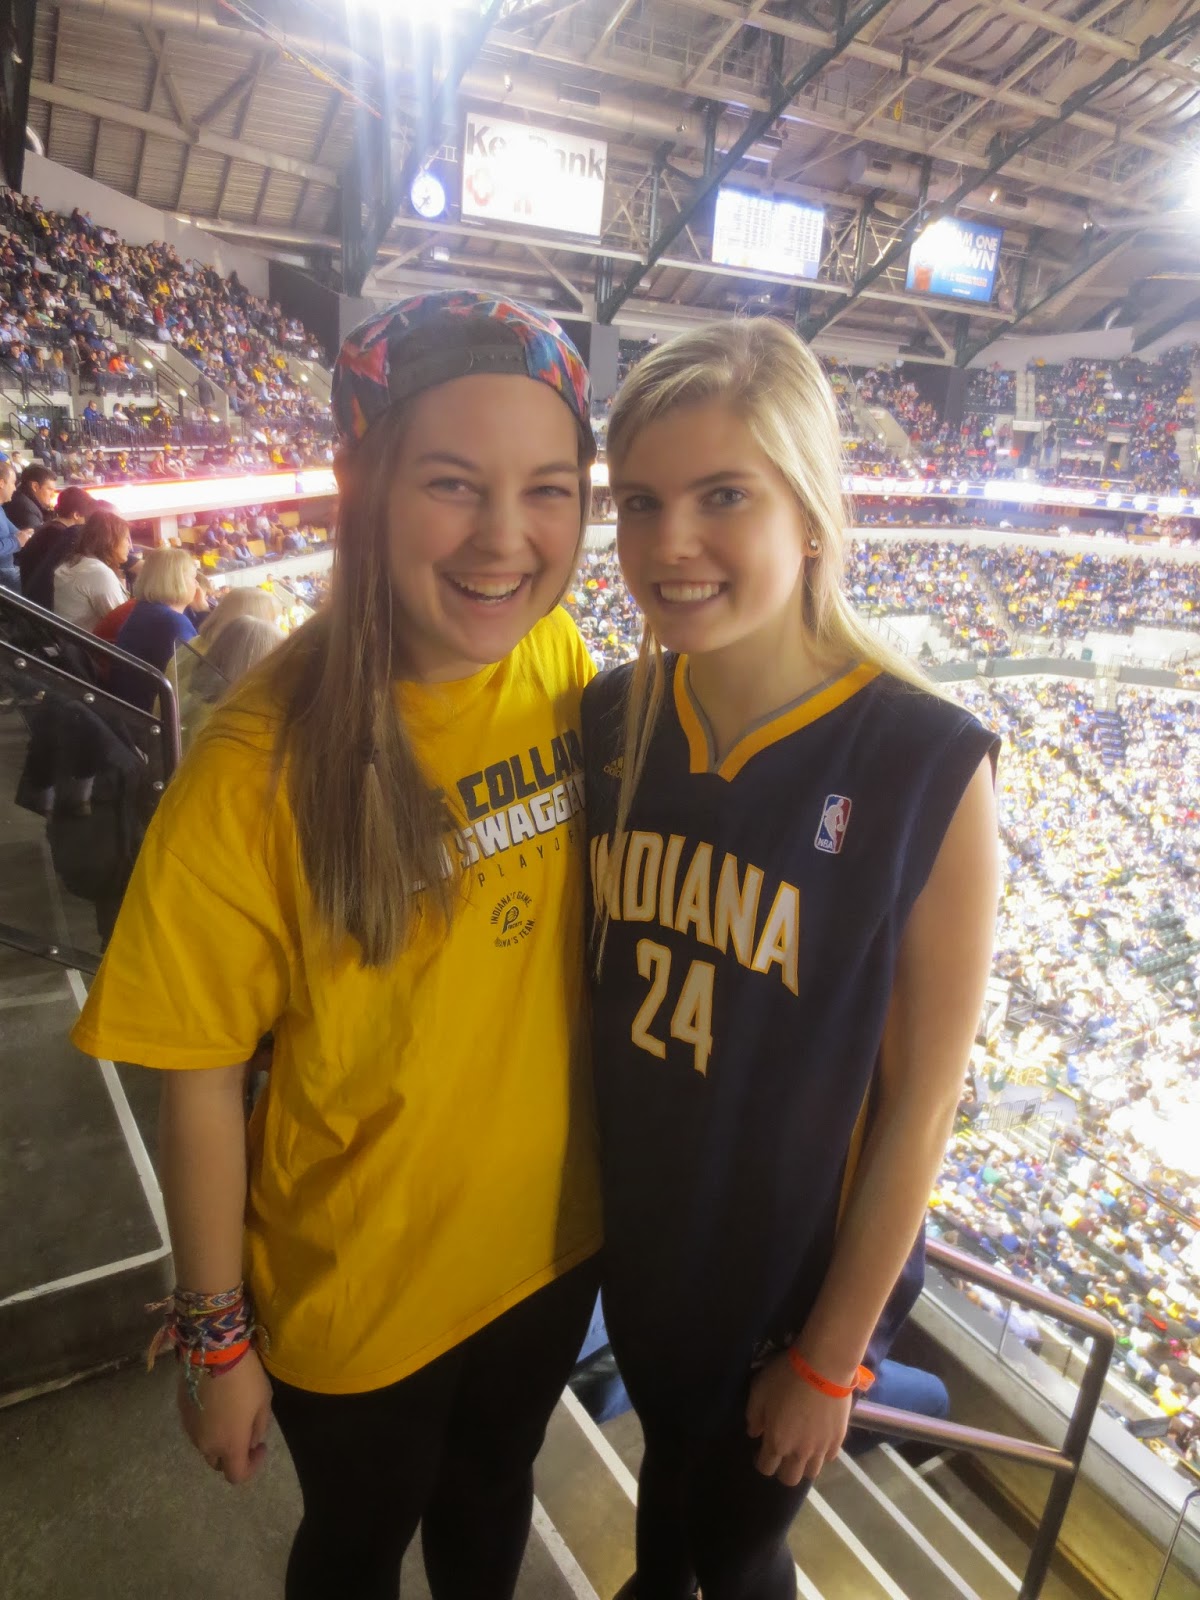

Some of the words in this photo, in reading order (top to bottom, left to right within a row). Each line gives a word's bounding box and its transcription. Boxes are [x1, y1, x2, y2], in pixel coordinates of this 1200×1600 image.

[466, 122, 605, 181] Keank
[975, 234, 999, 251] ONE
[817, 837, 833, 850] NBA
[590, 830, 800, 997] INDIANA
[631, 938, 716, 1079] 24
